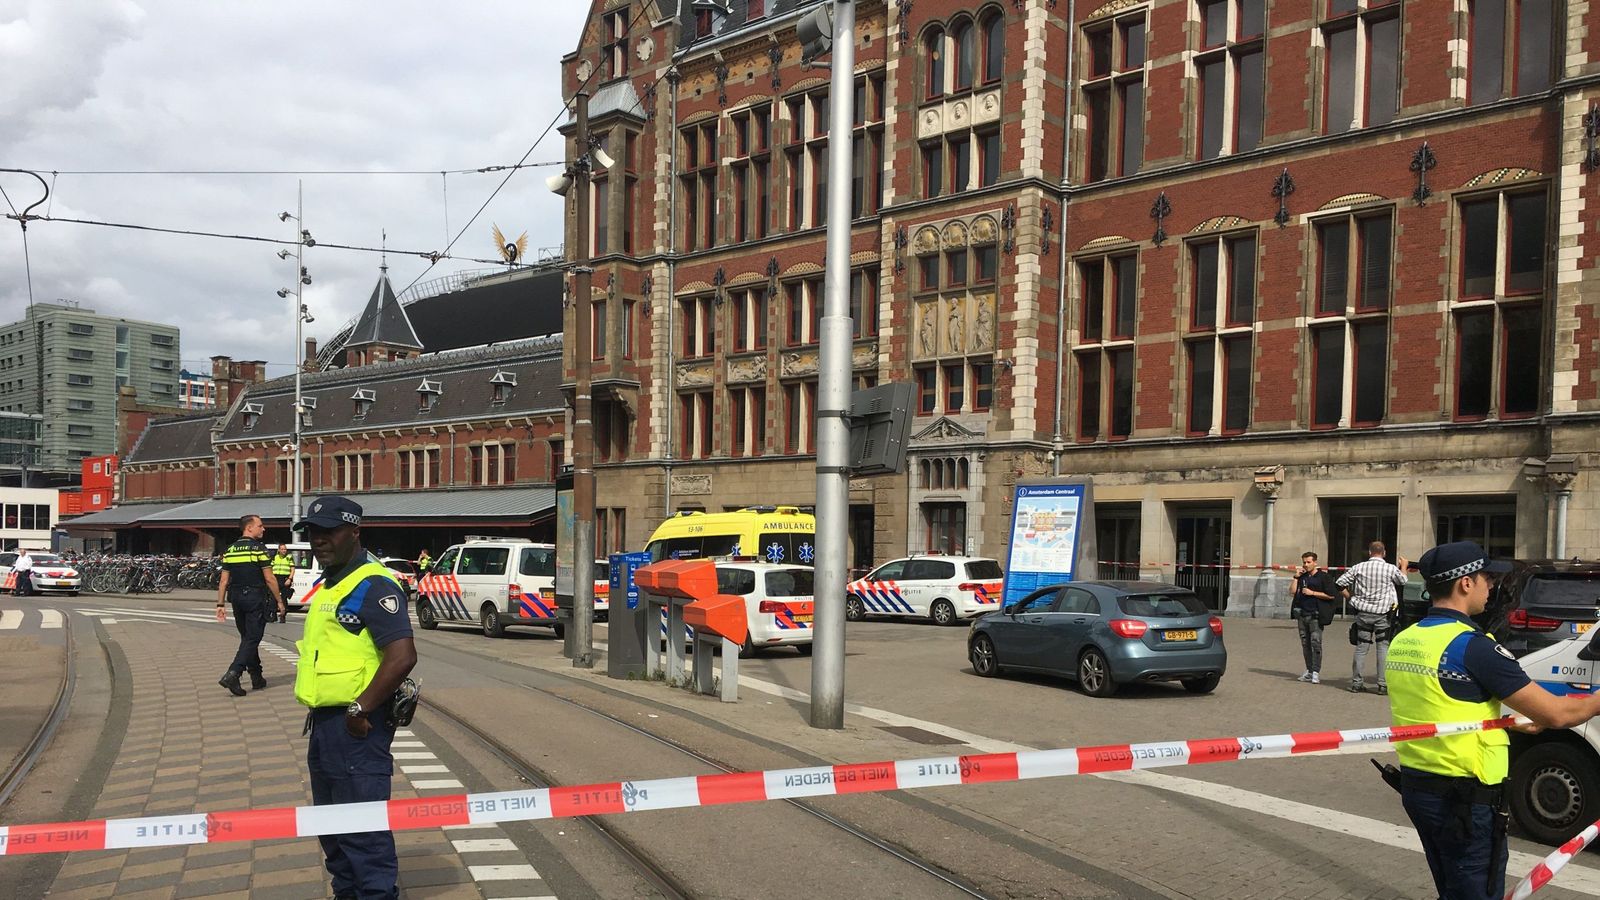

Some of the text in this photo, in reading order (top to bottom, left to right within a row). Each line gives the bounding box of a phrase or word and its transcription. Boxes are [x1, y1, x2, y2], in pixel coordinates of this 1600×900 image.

[1028, 487, 1054, 495] Amsterdam
[763, 522, 814, 530] AMBULANCE
[1561, 666, 1587, 676] OV 01
